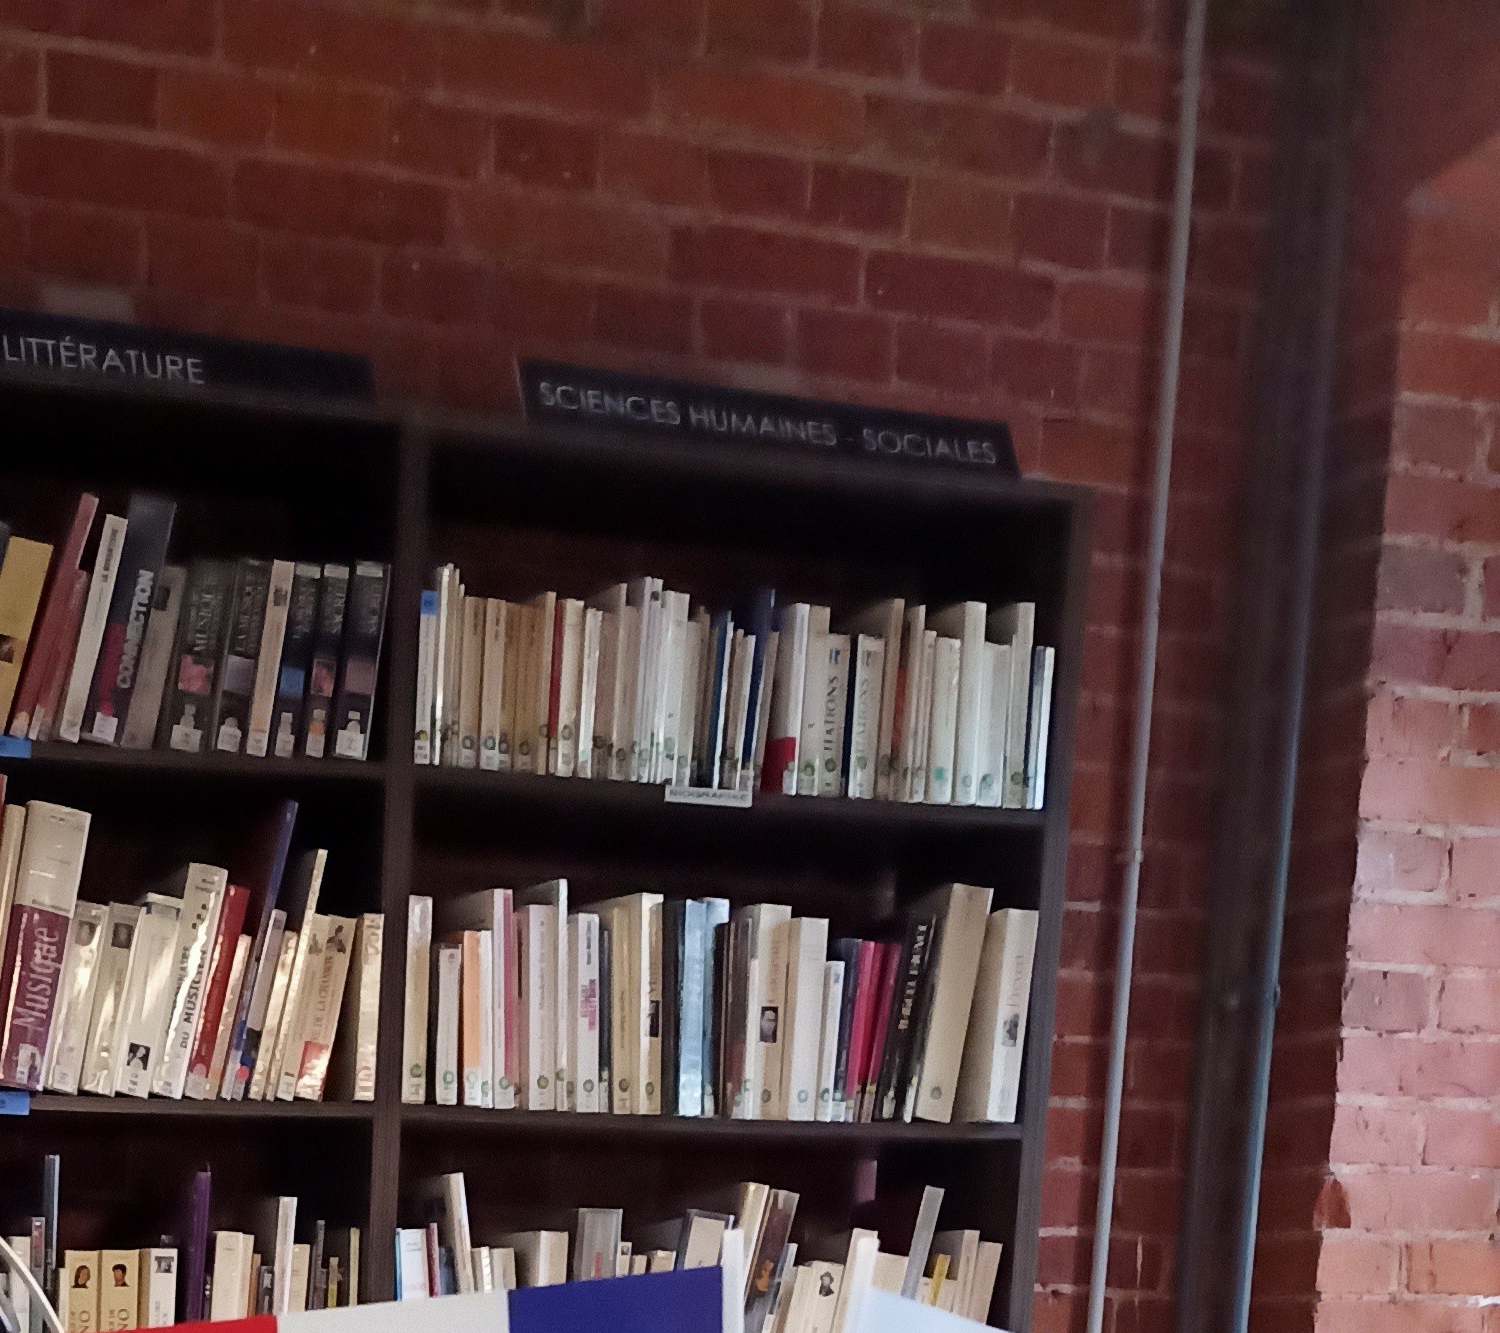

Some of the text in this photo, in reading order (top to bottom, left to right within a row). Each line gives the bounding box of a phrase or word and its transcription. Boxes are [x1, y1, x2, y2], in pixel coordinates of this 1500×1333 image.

[2, 335, 205, 385] LITTÉRATURE
[539, 381, 996, 465] SCIENCES HUMAINES SOCIALES
[12, 927, 62, 1032] Musique
